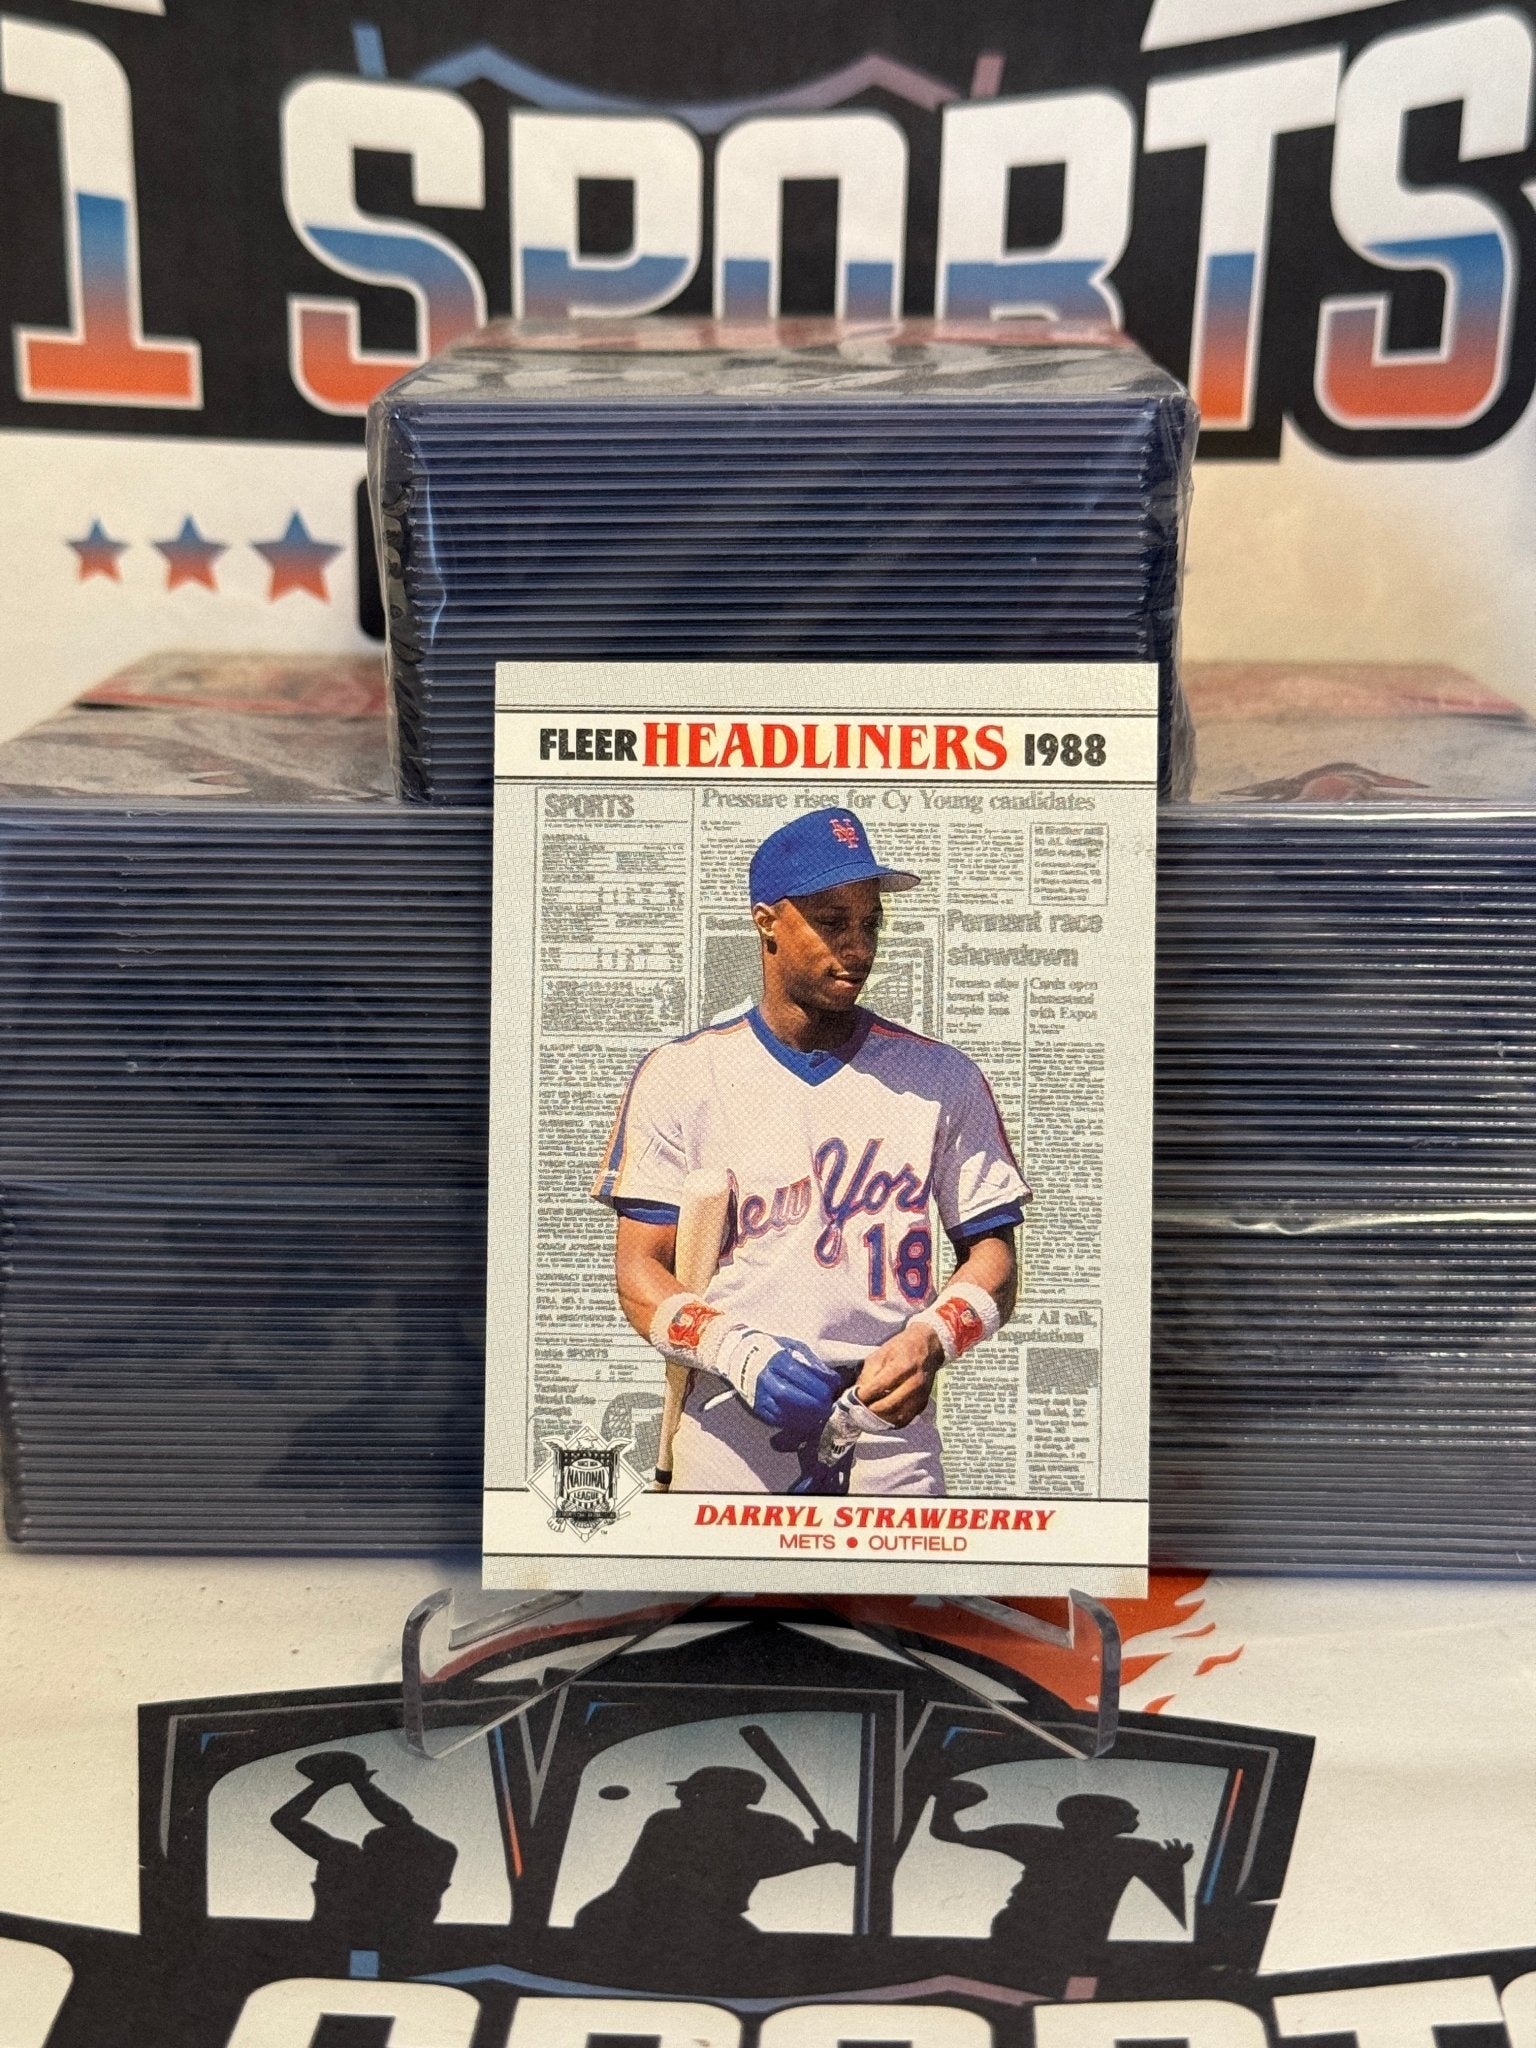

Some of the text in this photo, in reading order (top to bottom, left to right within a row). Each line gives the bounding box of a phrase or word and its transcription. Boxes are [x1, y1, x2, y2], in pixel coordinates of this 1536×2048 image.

[280, 10, 1520, 430] SPORTS
[539, 722, 1107, 771] FLEER HEADLINERS 1988
[544, 793, 635, 818] SPORTS
[701, 788, 1096, 814] Pressure rises for Cy Young candidates
[813, 1136, 933, 1268] Yor
[863, 1222, 932, 1304] 18
[566, 1469, 609, 1491] NATIONAL
[573, 1491, 600, 1500] LEAGUE
[694, 1504, 1056, 1531] DARRYL STRAWBERRY
[779, 1533, 968, 1552] METS OUTFIELD
